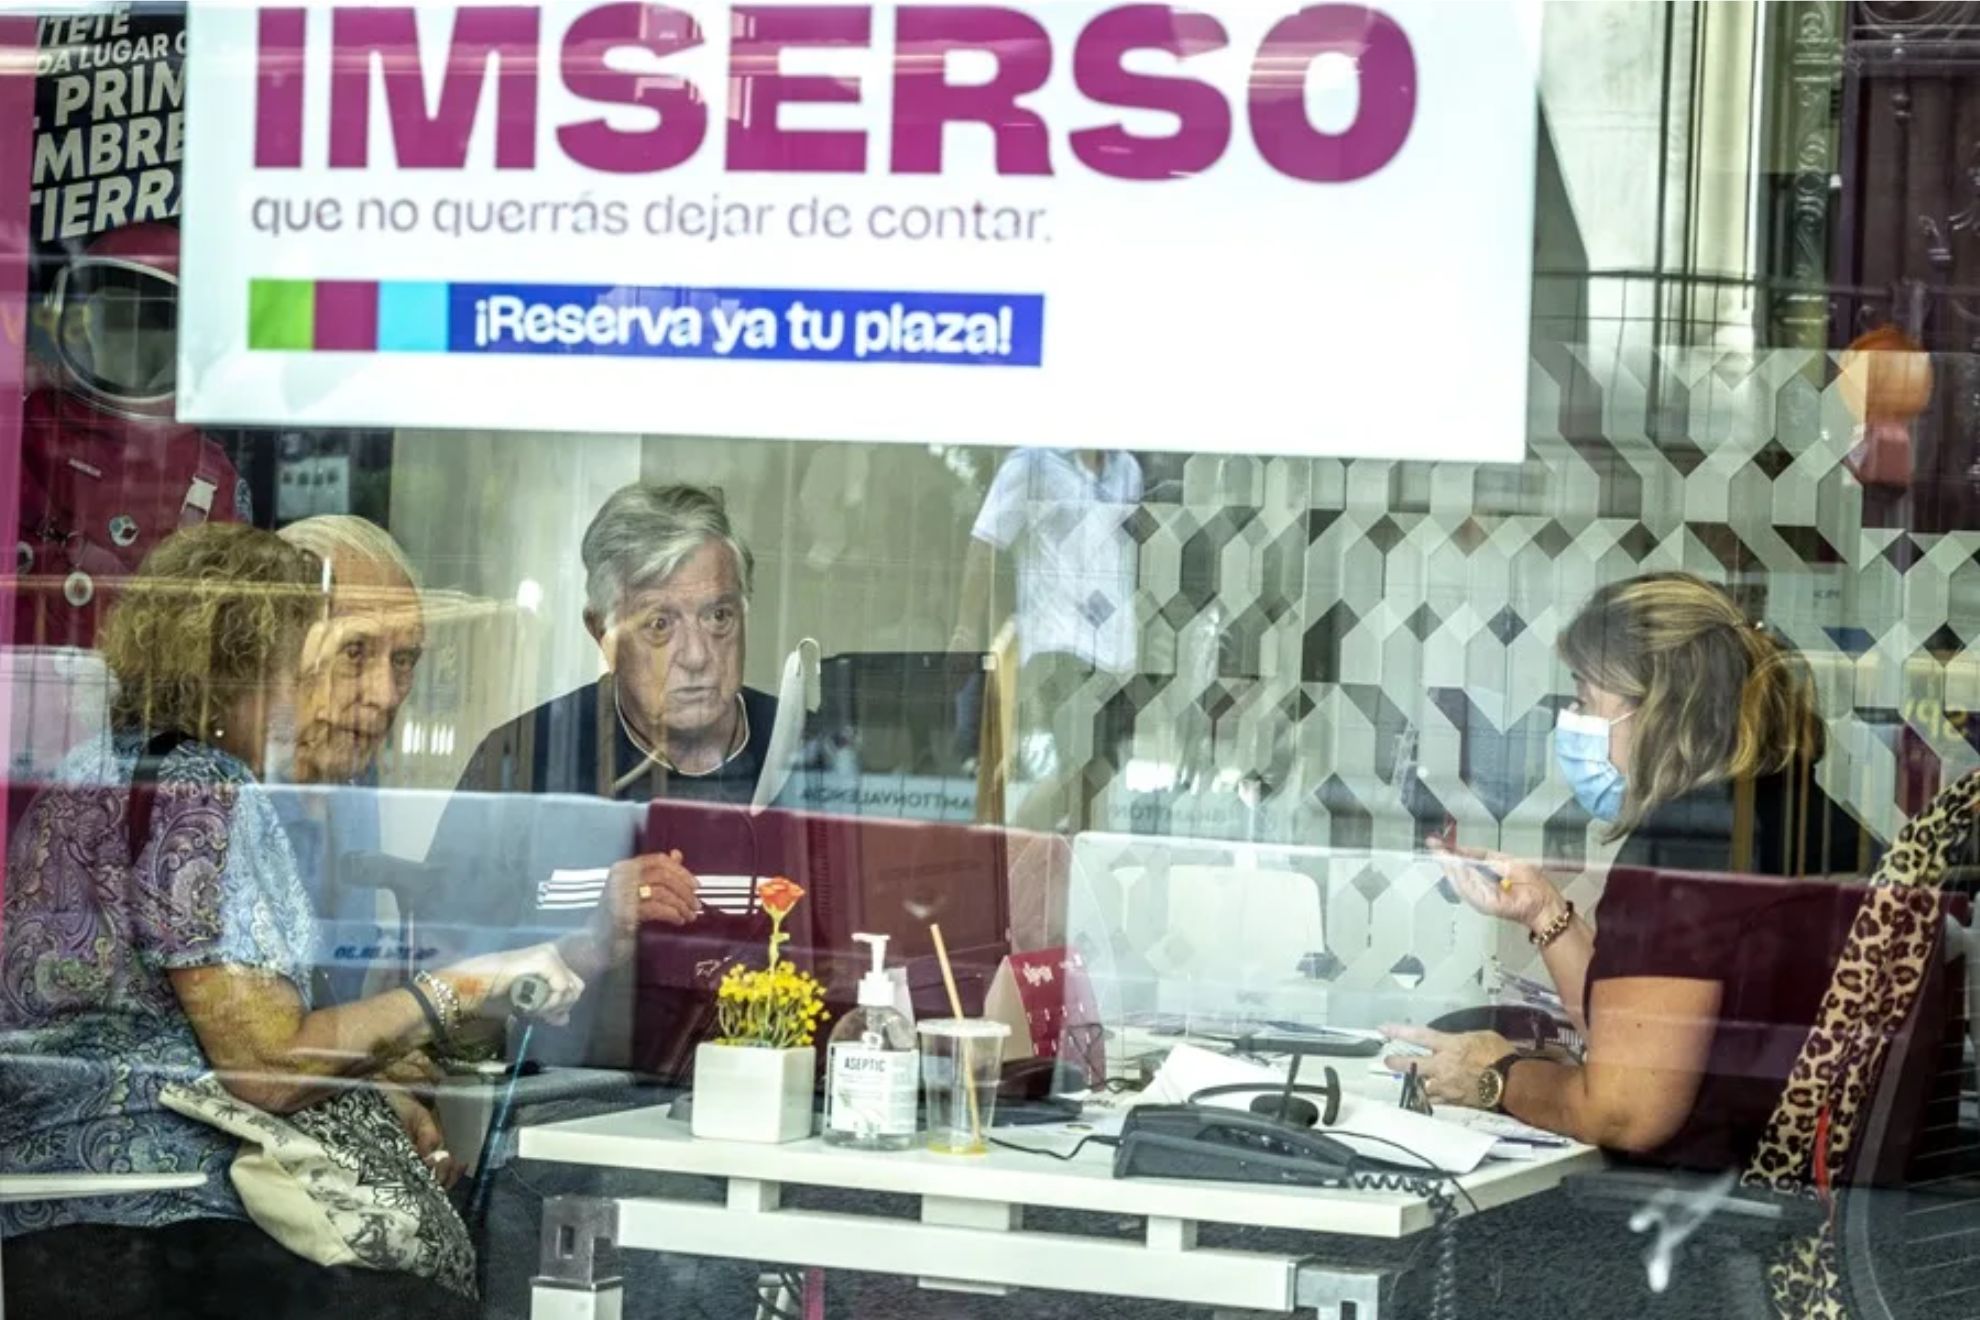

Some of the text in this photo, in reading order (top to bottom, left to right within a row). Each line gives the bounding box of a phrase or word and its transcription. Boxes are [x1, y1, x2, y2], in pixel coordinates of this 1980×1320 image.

[78, 34, 169, 69] LUGAR
[253, 2, 1418, 183] IMSERSO
[252, 190, 1052, 243] que no querrás dejar de contar.
[474, 295, 1013, 358] ¡Reserva ya tu plaza!
[844, 1057, 886, 1072] ASEPTIC
